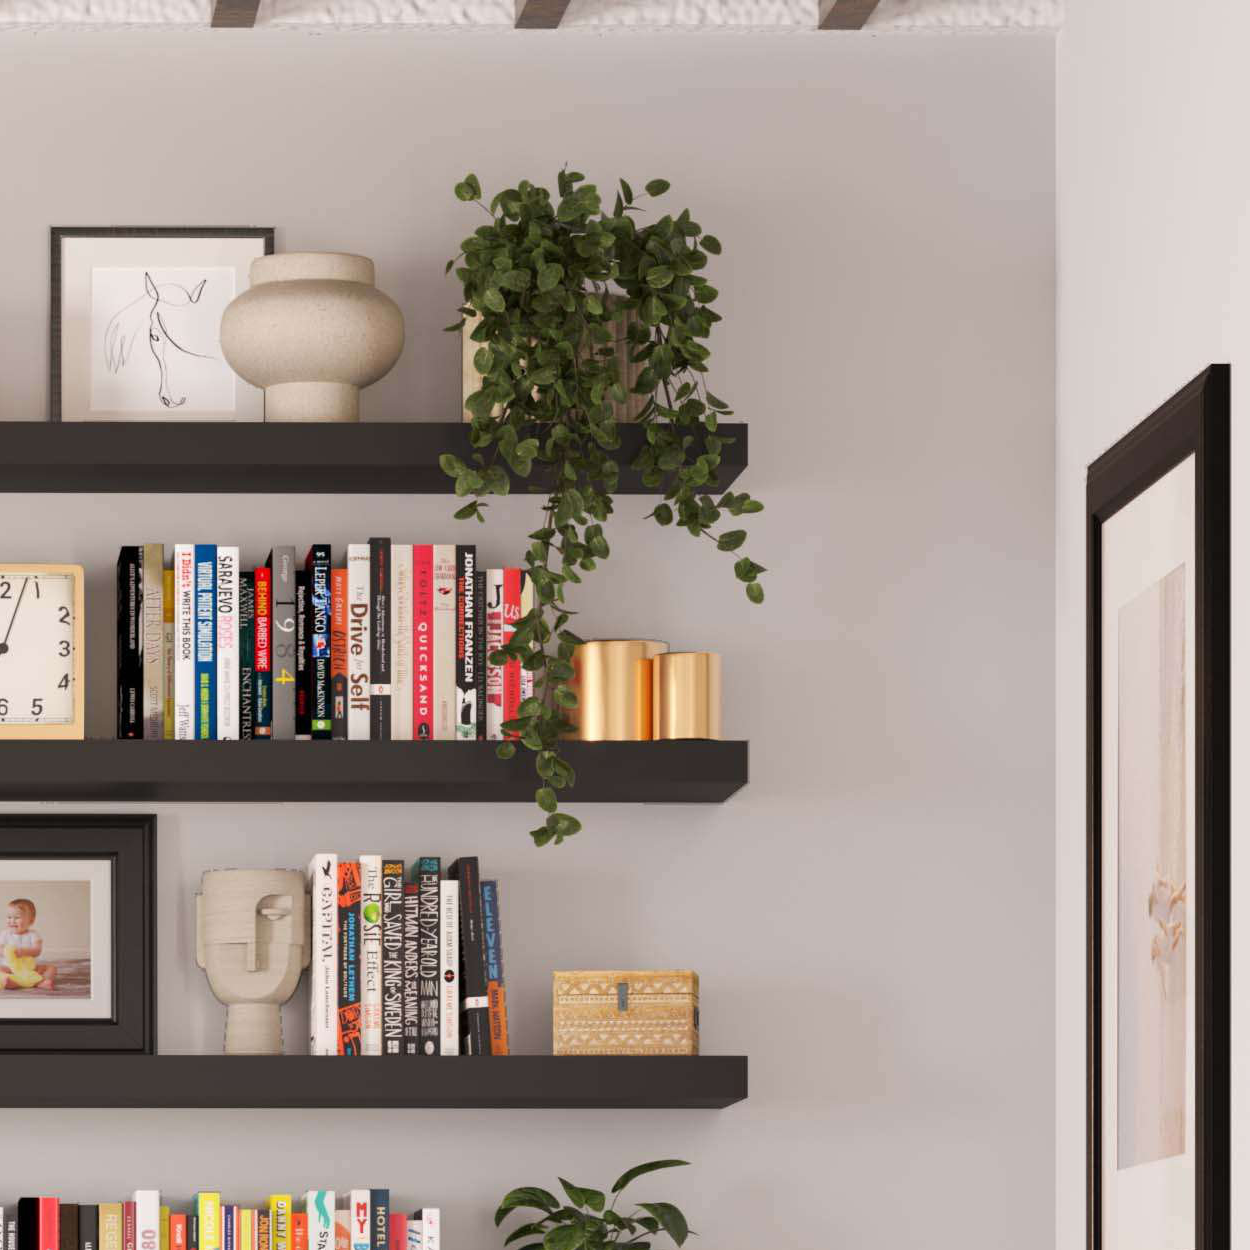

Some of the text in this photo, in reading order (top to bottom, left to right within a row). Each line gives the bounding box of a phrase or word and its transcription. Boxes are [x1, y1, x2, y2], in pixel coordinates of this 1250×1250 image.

[218, 556, 232, 613] SARAJEVO
[58, 606, 70, 625] 2
[182, 591, 191, 615] WRITE
[465, 552, 473, 682] JONATHAN FRANZEN
[182, 618, 191, 635] THIS
[257, 581, 267, 669] BEHIND BARBED WIRE
[58, 640, 70, 657] 3
[182, 638, 191, 660] BOOK
[58, 674, 70, 690] 4
[418, 622, 427, 715] QUICKSAND
[31, 699, 43, 716] 5
[384, 914, 401, 950] SAVED
[405, 896, 418, 937] HITMAN
[384, 960, 401, 987] KING
[405, 940, 418, 978] ANDERS
[384, 993, 402, 1037] SWEDEN
[141, 1230, 156, 1249] 80
[377, 1207, 385, 1246] HOTEL
